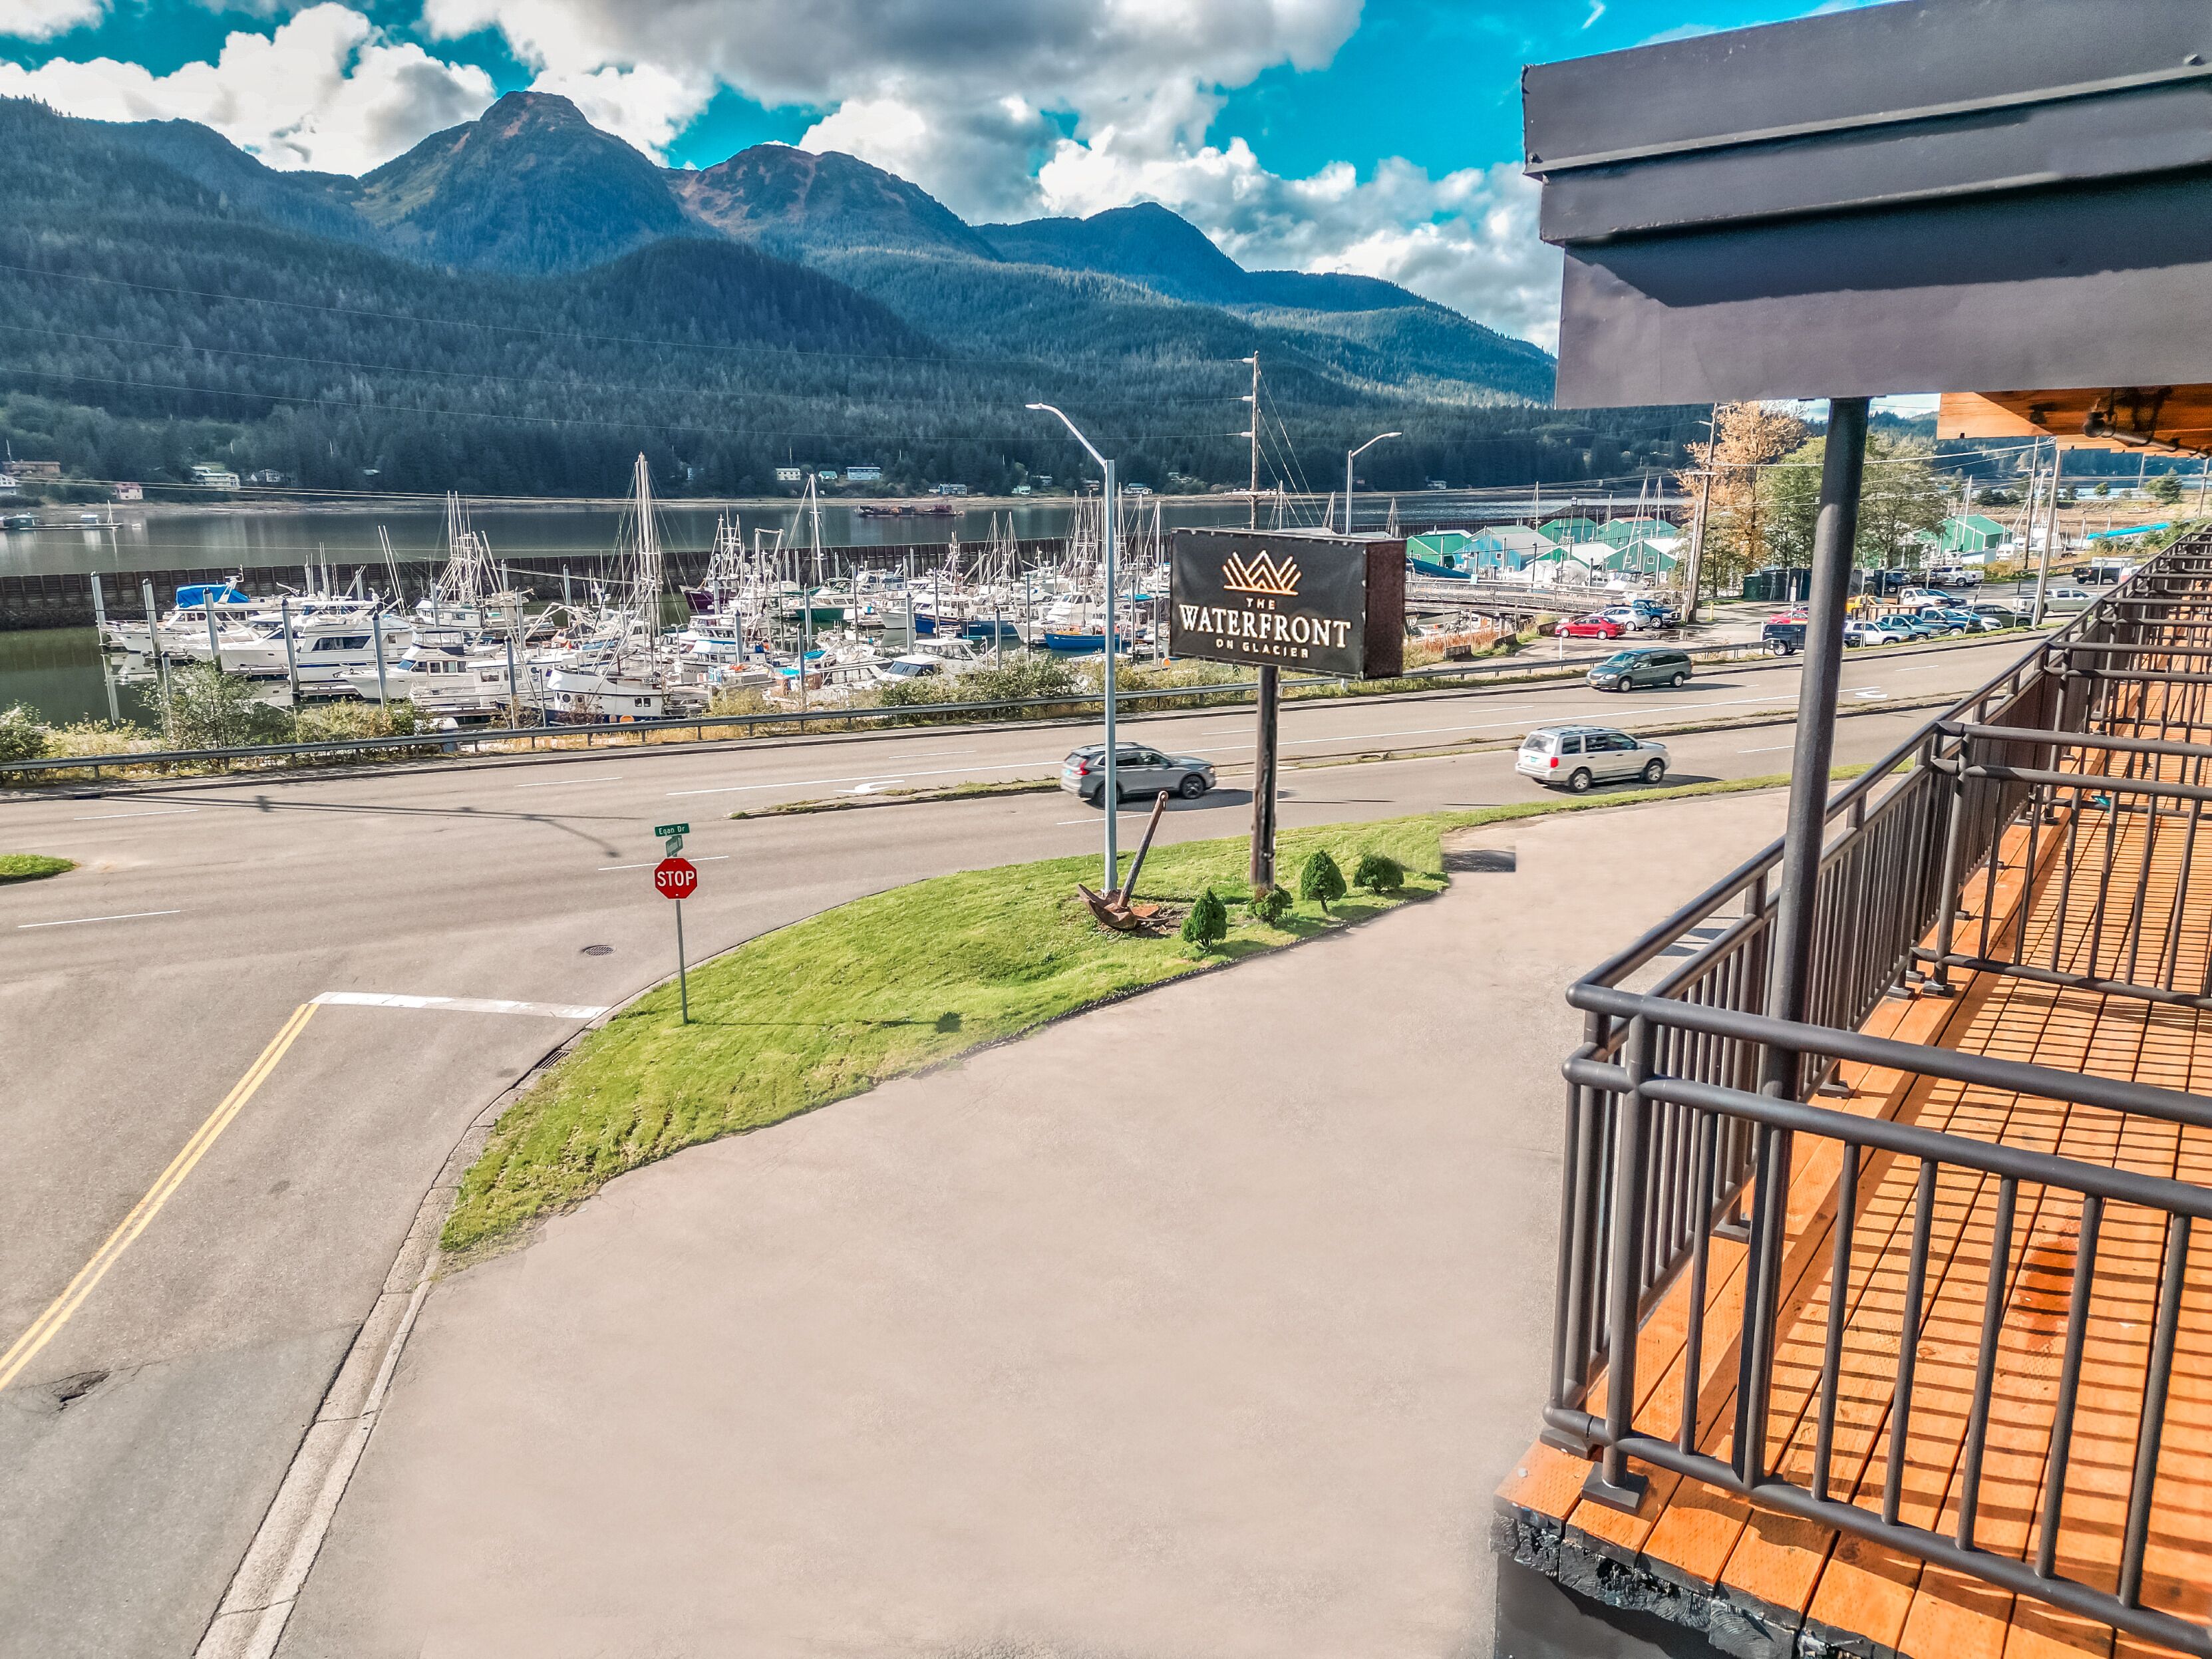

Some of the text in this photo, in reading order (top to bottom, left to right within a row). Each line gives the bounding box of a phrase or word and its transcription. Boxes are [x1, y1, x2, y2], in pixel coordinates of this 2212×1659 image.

[1246, 597, 1275, 610] THE
[1179, 604, 1351, 649] WATERFRONT
[1215, 639, 1309, 659] ON GLACIER
[657, 870, 695, 887] STOP
